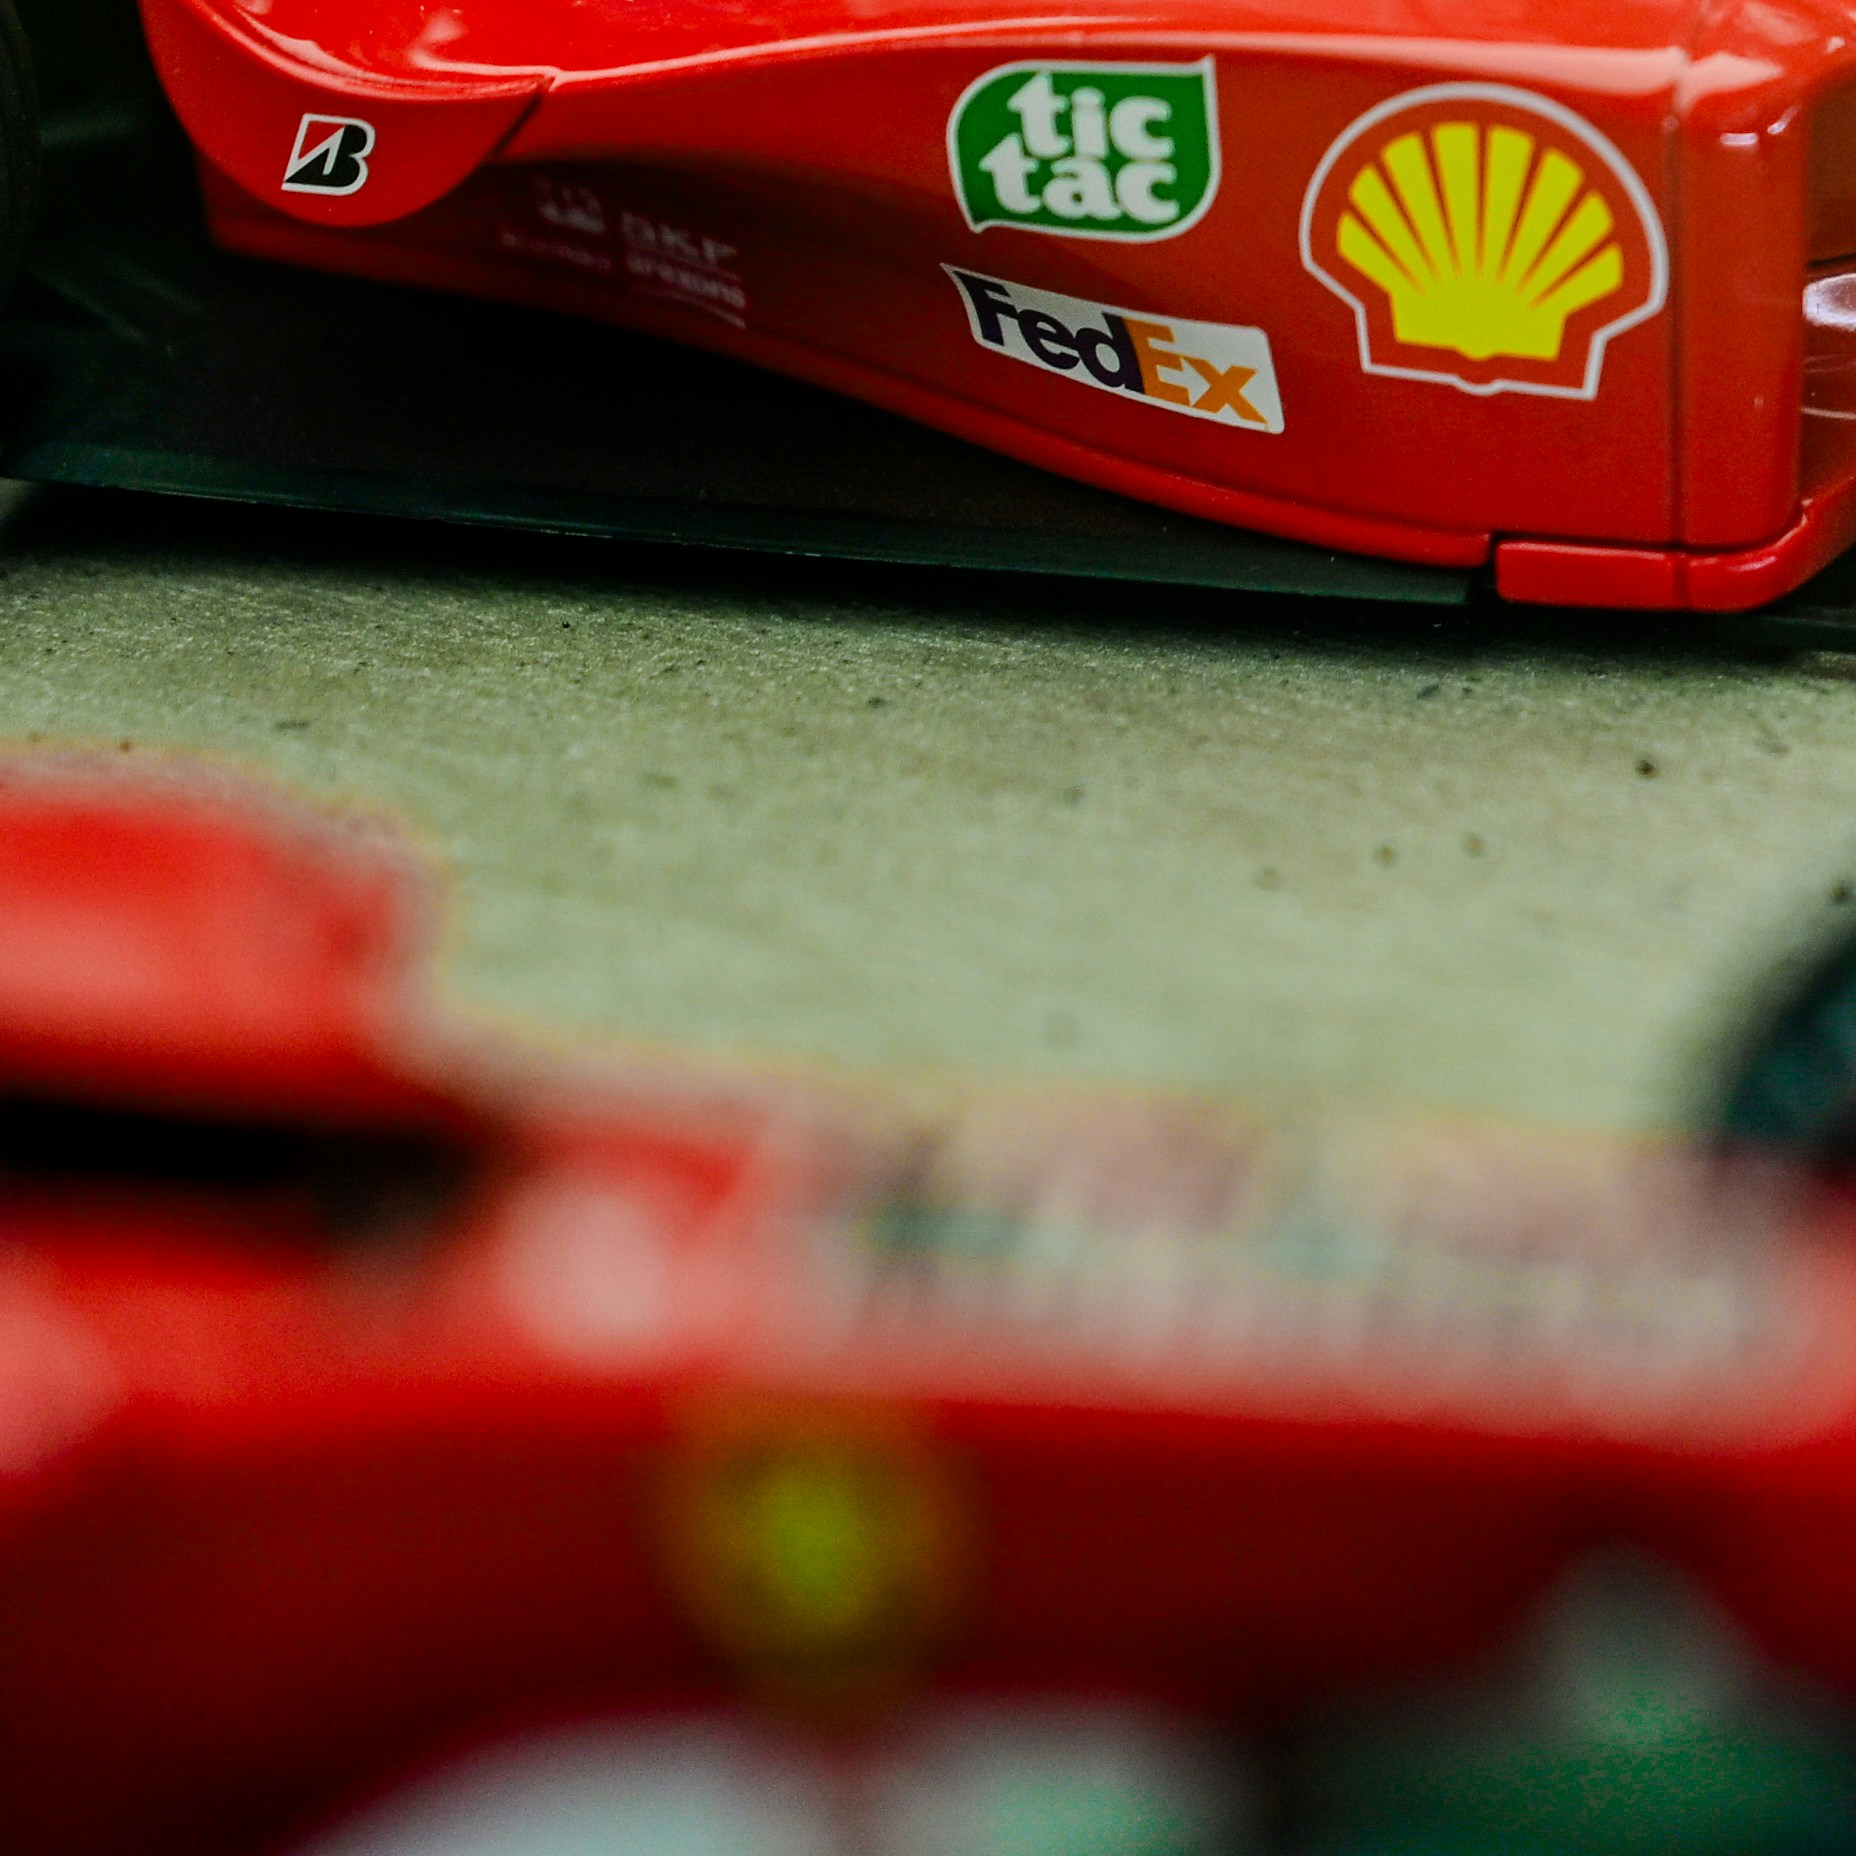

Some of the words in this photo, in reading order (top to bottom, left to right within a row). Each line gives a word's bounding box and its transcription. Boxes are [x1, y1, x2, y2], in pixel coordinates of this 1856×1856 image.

[1007, 73, 1175, 160] tic
[979, 134, 1180, 222] tac
[955, 266, 1269, 425] FedEx
